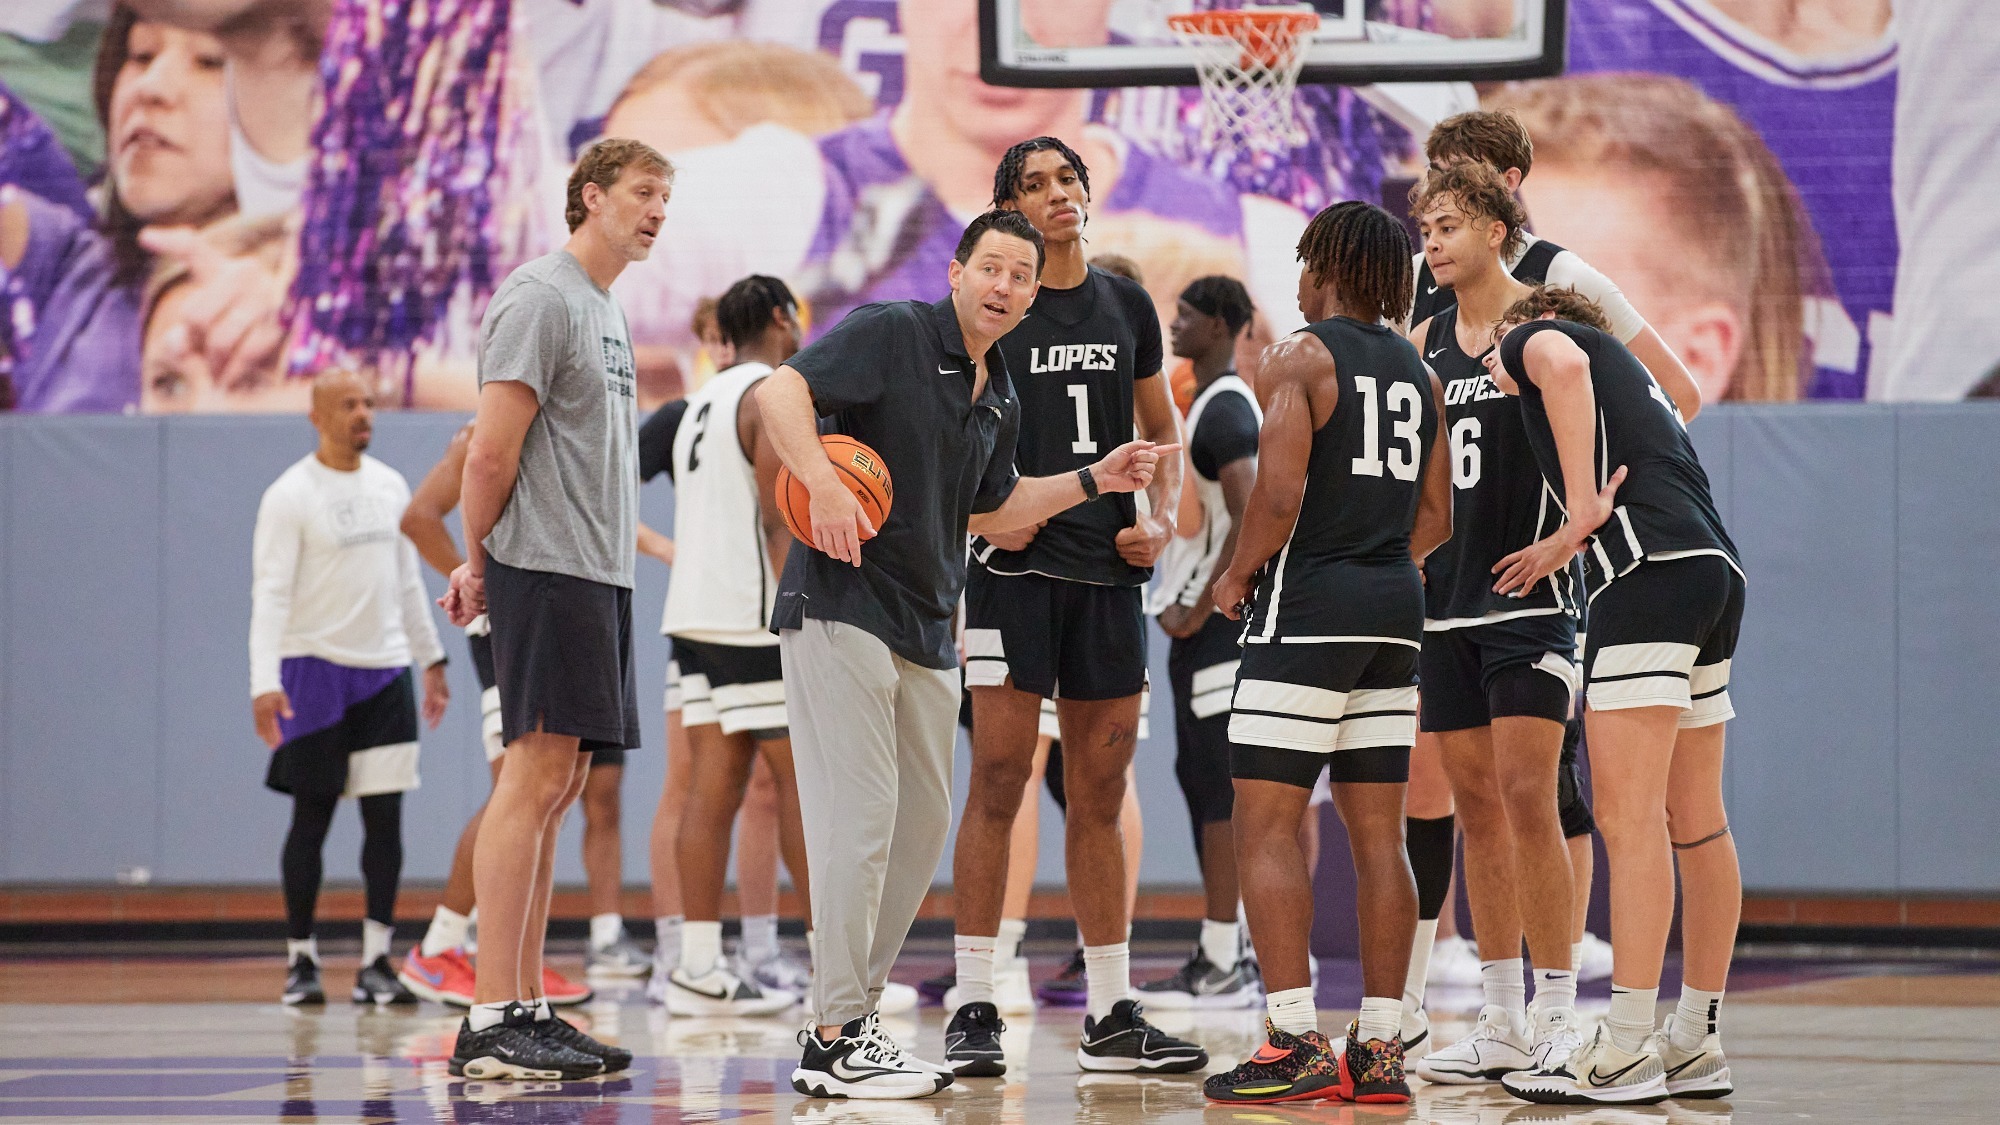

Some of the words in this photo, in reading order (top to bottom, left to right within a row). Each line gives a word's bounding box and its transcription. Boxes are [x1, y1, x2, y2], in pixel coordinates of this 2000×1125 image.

[1030, 344, 1118, 374] LOPES
[1444, 374, 1506, 406] OPES
[689, 402, 711, 472] 2
[1067, 384, 1098, 454] 1
[1352, 376, 1422, 482] 13
[1450, 416, 1482, 490] 6
